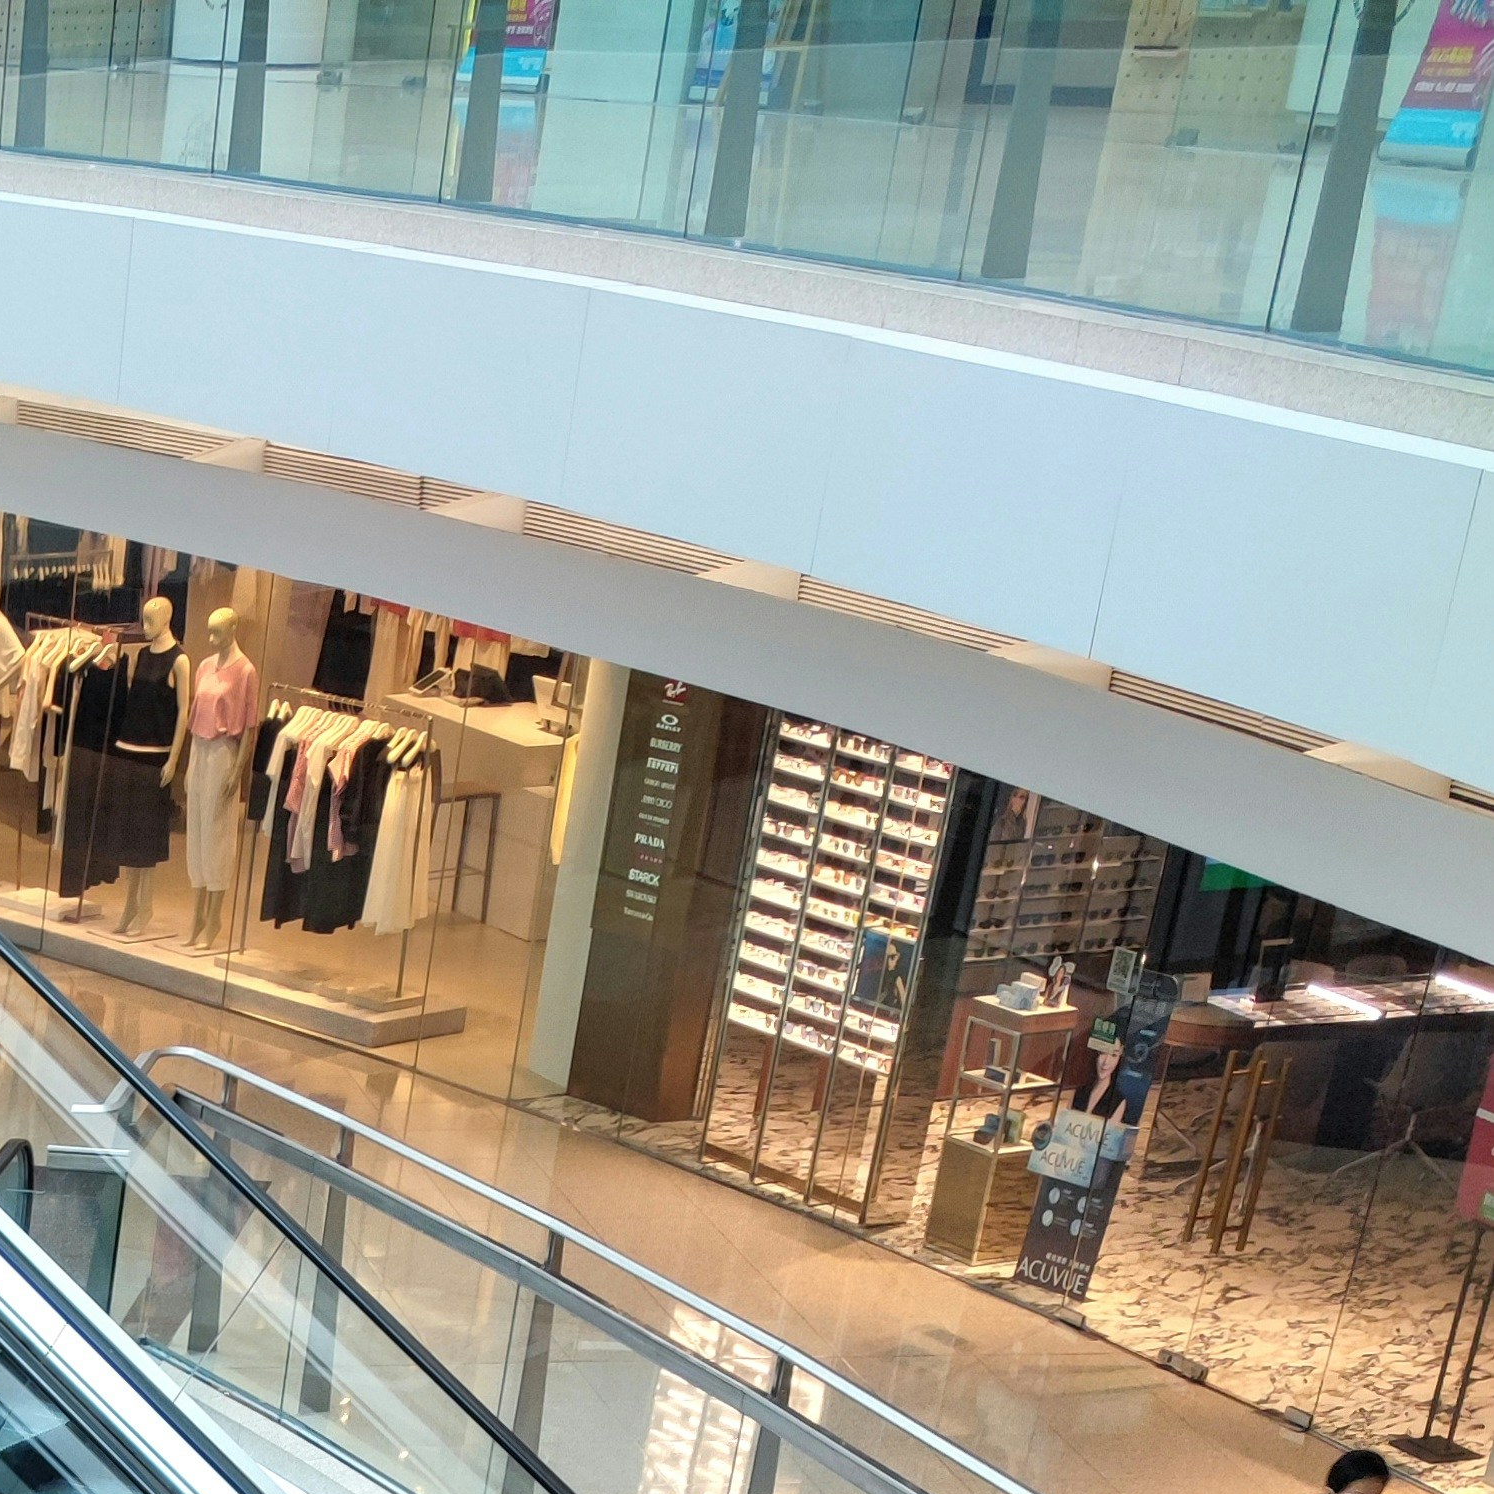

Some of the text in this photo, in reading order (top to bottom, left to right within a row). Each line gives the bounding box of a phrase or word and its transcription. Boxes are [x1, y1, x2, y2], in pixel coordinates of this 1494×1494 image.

[634, 832, 666, 850] PRADA
[628, 868, 661, 887] STARCK
[1064, 1121, 1111, 1149] ACUVUE
[1040, 1149, 1086, 1176] ACUVUE
[1016, 1255, 1088, 1296] ACUVUE
